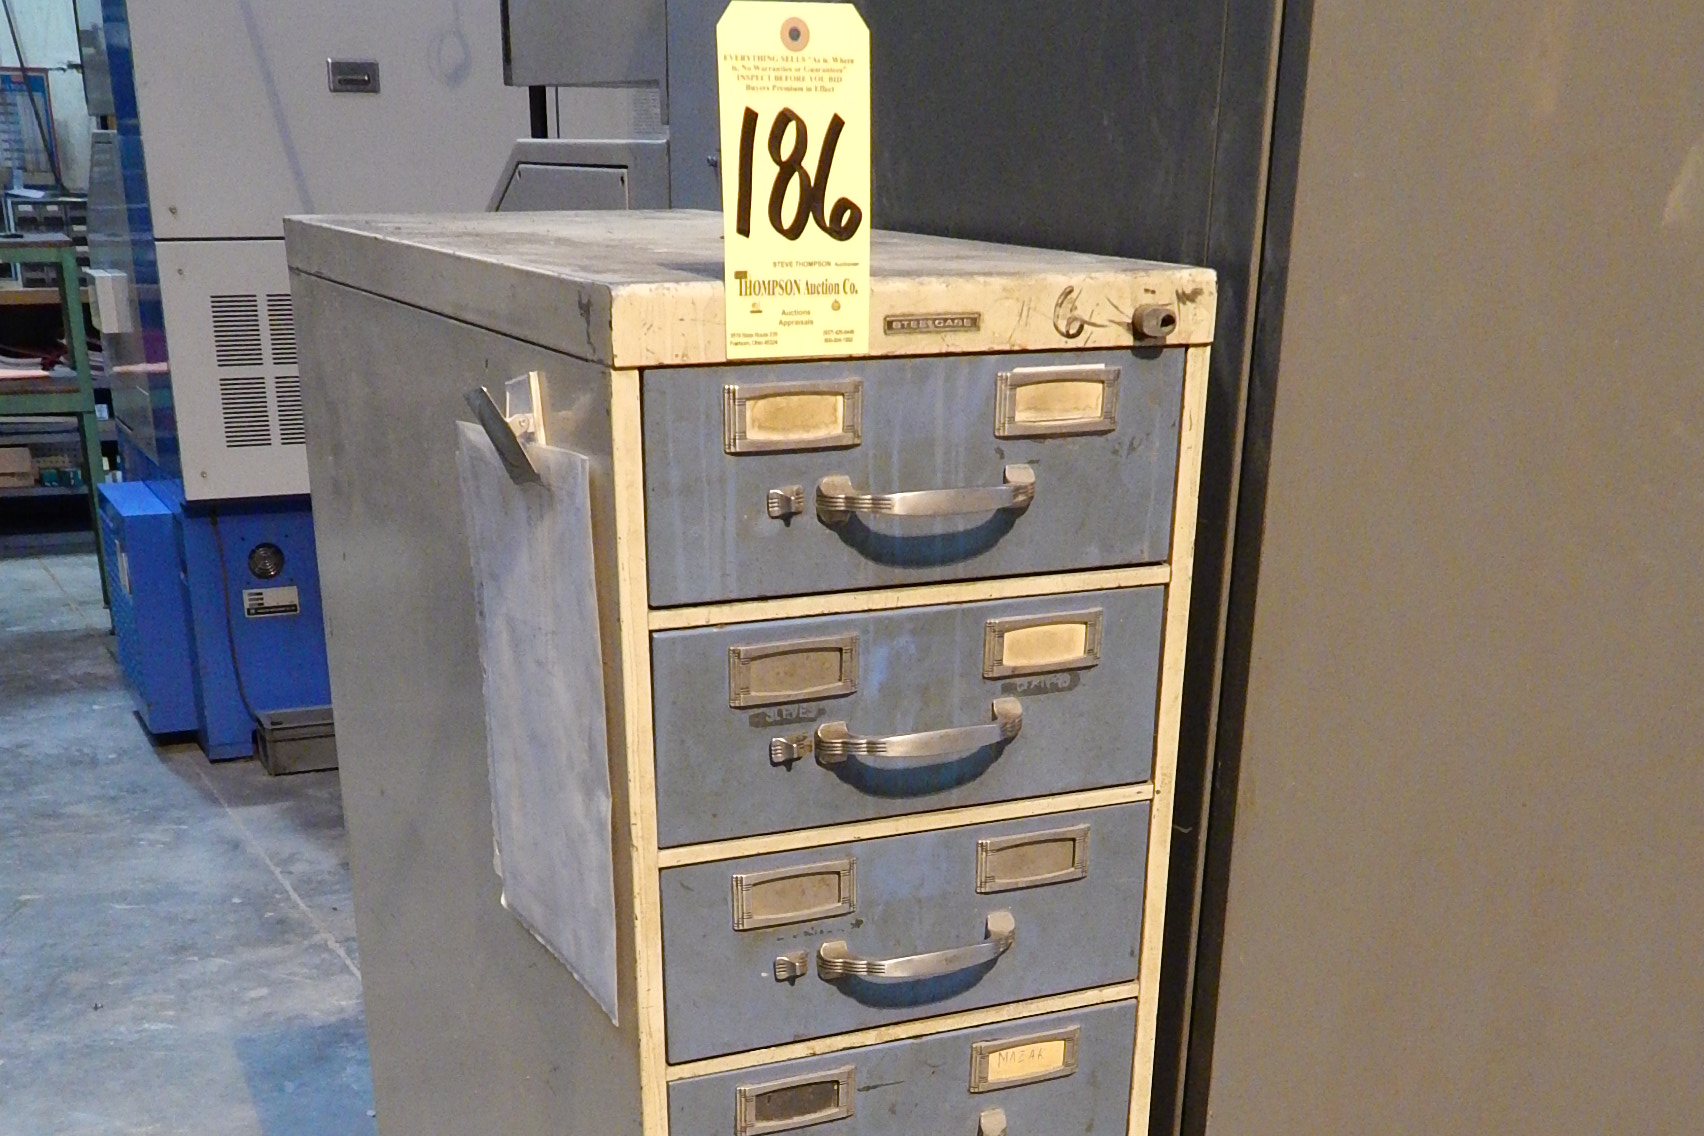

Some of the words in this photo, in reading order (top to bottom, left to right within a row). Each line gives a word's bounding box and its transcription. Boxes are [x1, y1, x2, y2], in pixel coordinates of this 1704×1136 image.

[772, 84, 804, 92] Premium
[736, 106, 863, 241] 186
[795, 260, 831, 268] THOMPSON
[735, 271, 802, 297] THOMPSON
[804, 278, 840, 296] Auction
[842, 278, 858, 295] Co.
[778, 319, 814, 327] Appraisals
